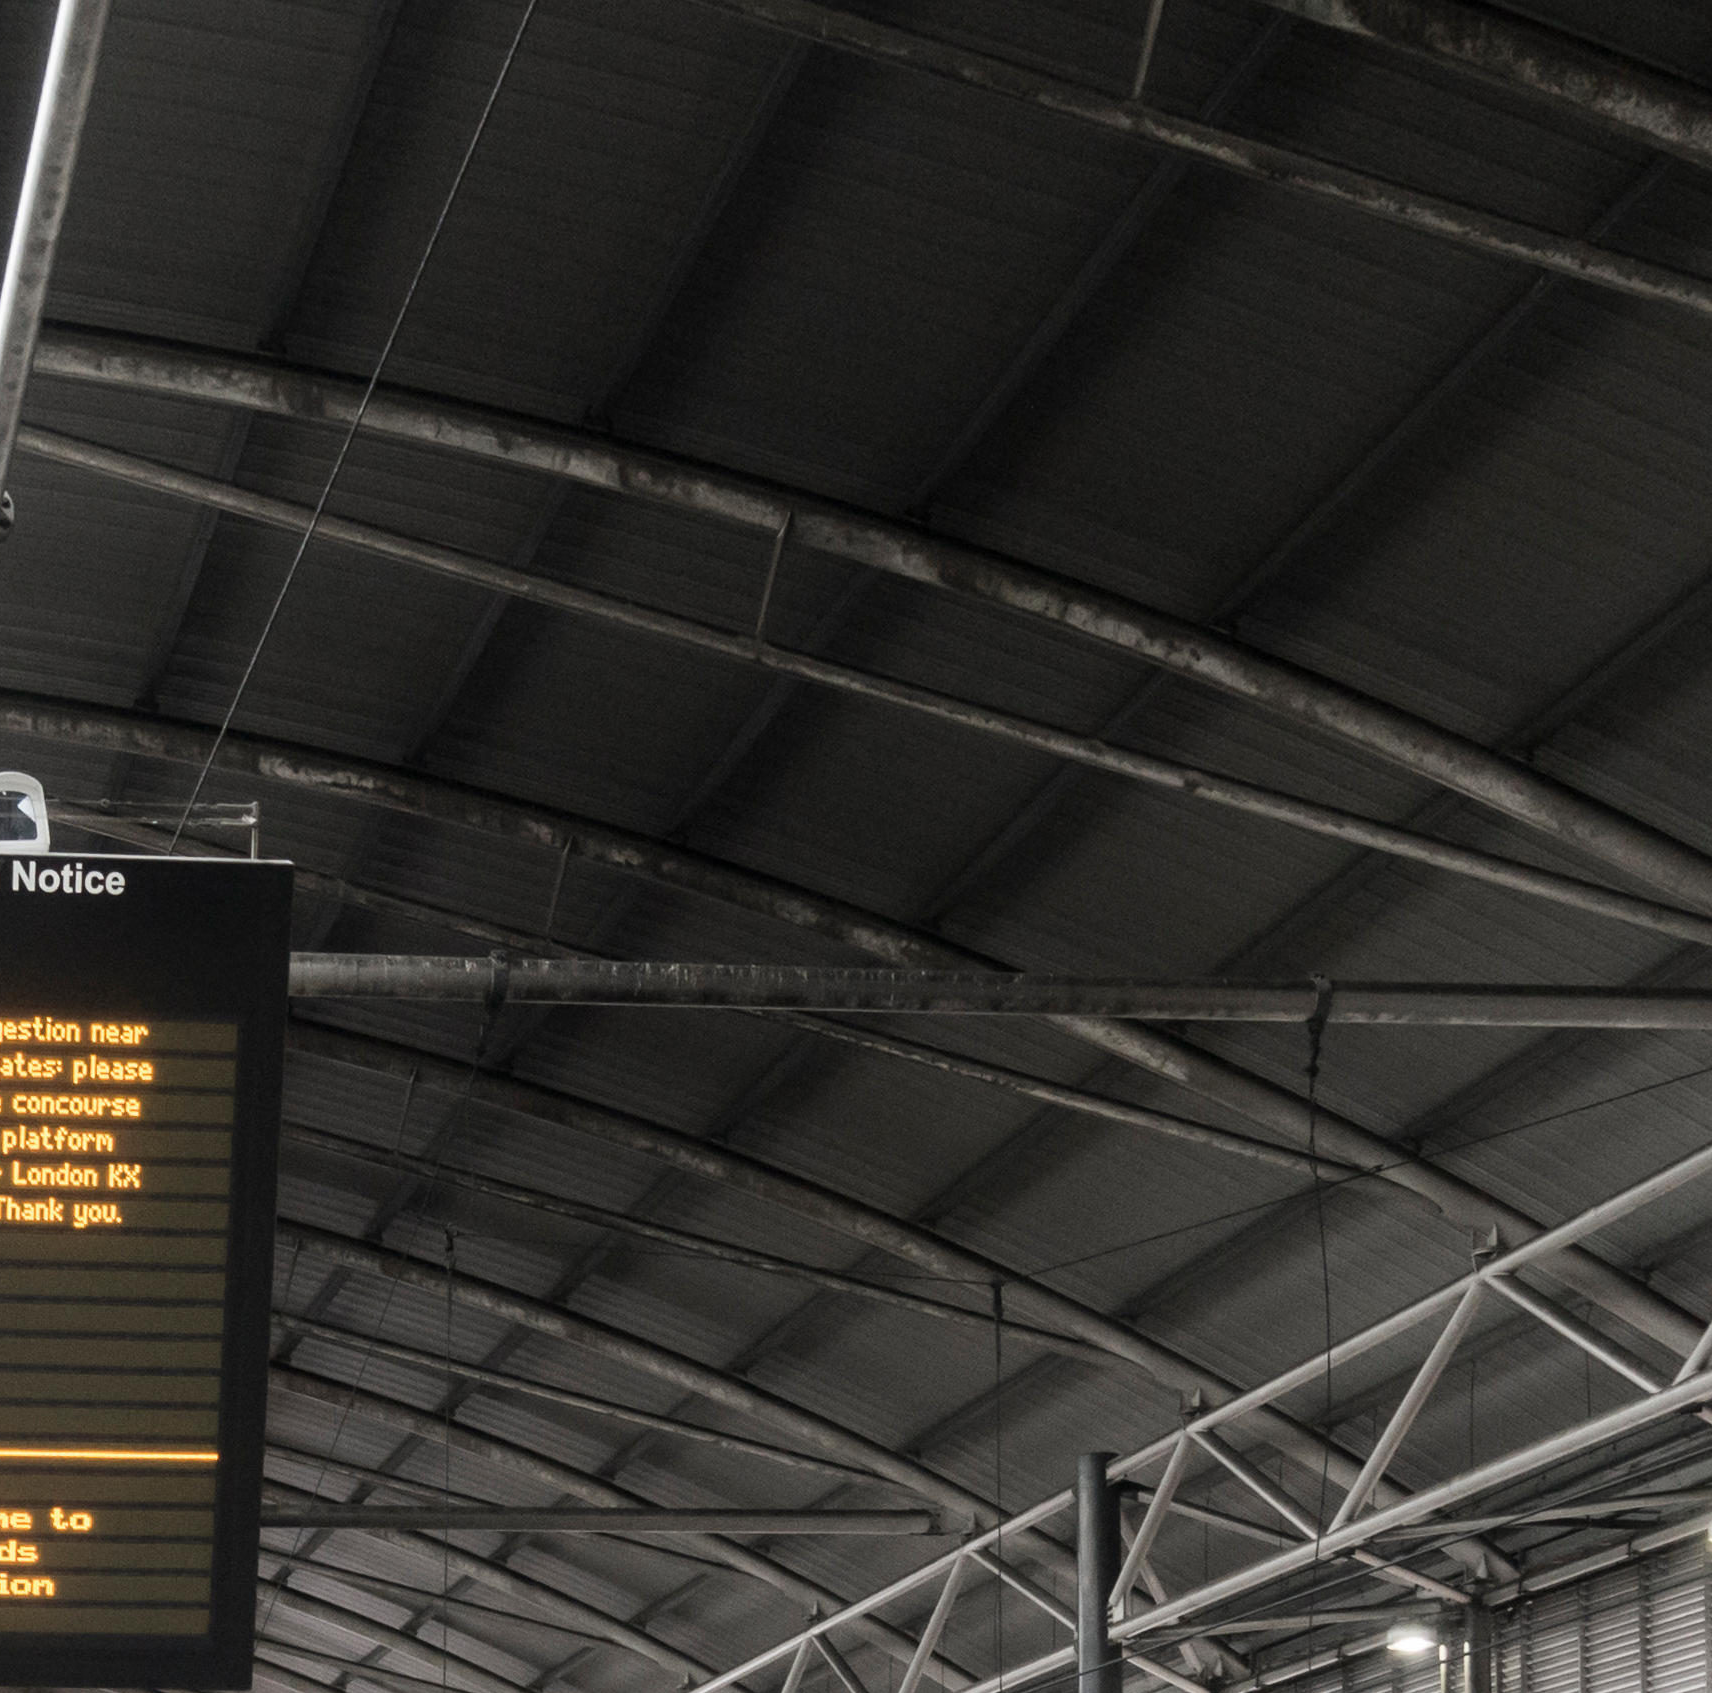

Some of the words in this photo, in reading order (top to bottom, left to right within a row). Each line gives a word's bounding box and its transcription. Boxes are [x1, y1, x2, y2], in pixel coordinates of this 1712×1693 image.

[12, 861, 126, 895] Notice
[90, 1023, 149, 1044] near
[73, 1055, 153, 1084] please
[12, 1094, 141, 1118] concourse
[2, 1125, 114, 1154] platform
[12, 1160, 99, 1187] London
[108, 1164, 141, 1188] KX
[73, 1204, 122, 1228] you.
[50, 1507, 92, 1531] to
